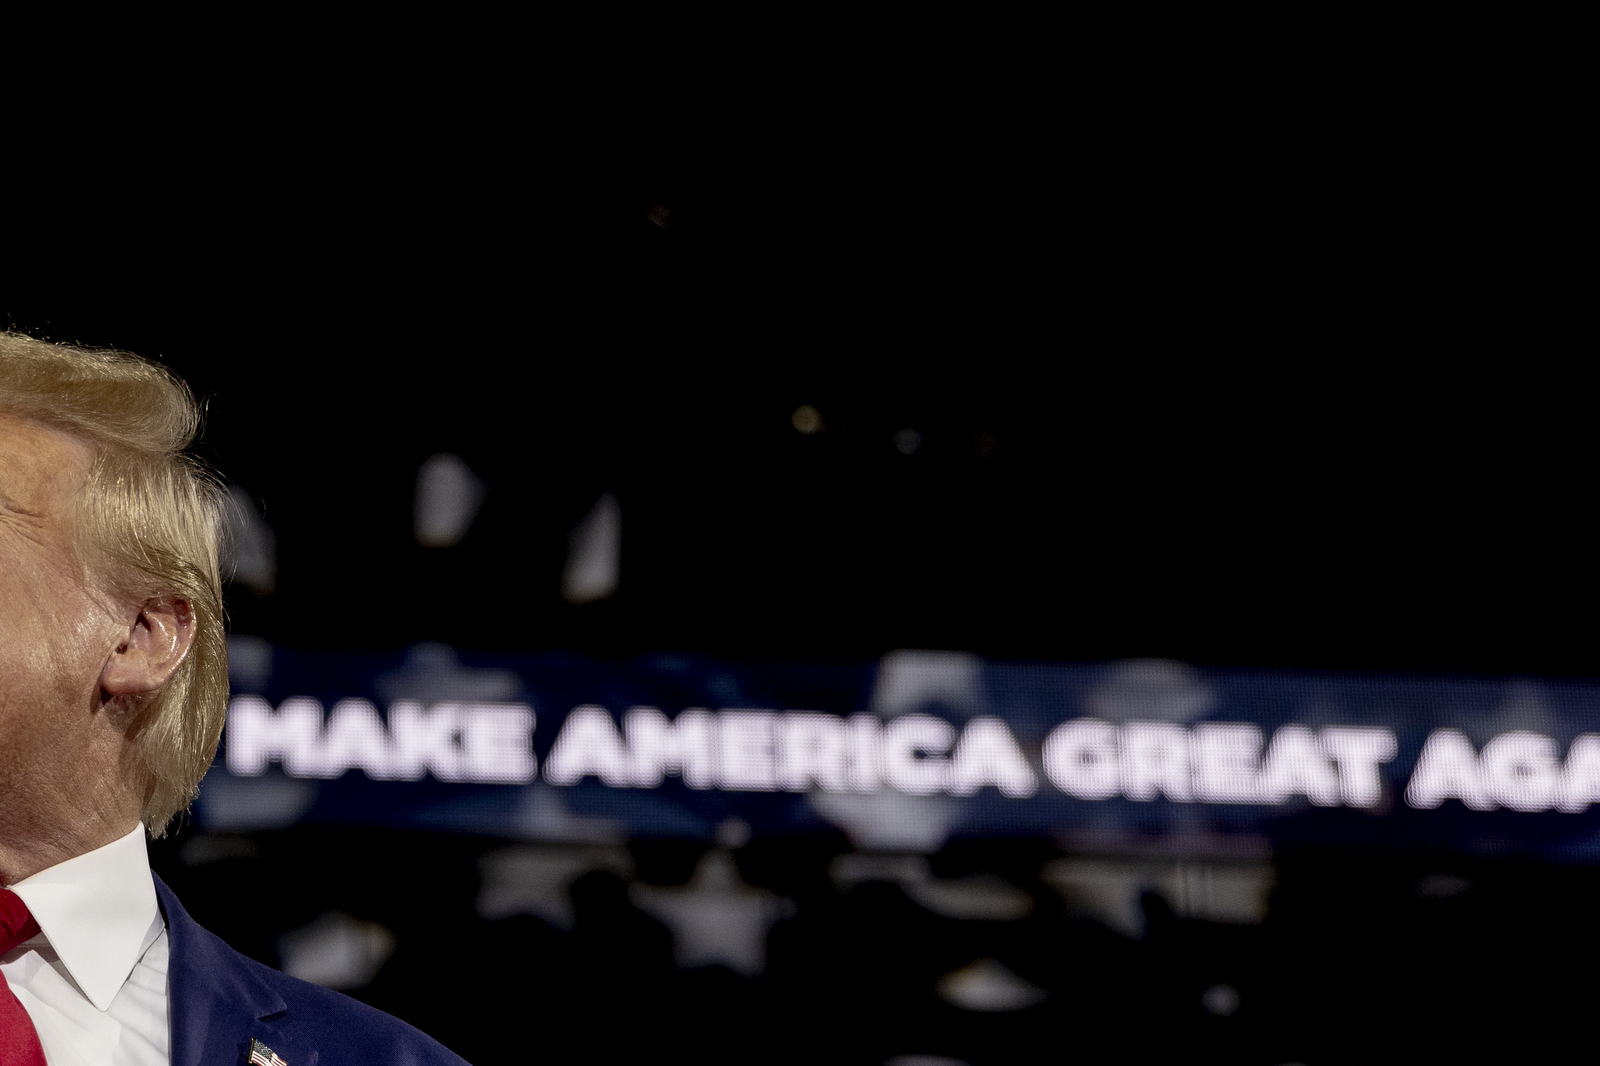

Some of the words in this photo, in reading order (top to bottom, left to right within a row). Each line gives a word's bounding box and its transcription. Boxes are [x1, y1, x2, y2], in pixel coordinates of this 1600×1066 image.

[227, 696, 536, 785] MAKE
[543, 704, 1038, 798] AMERICA
[1042, 717, 1398, 809] GREAT
